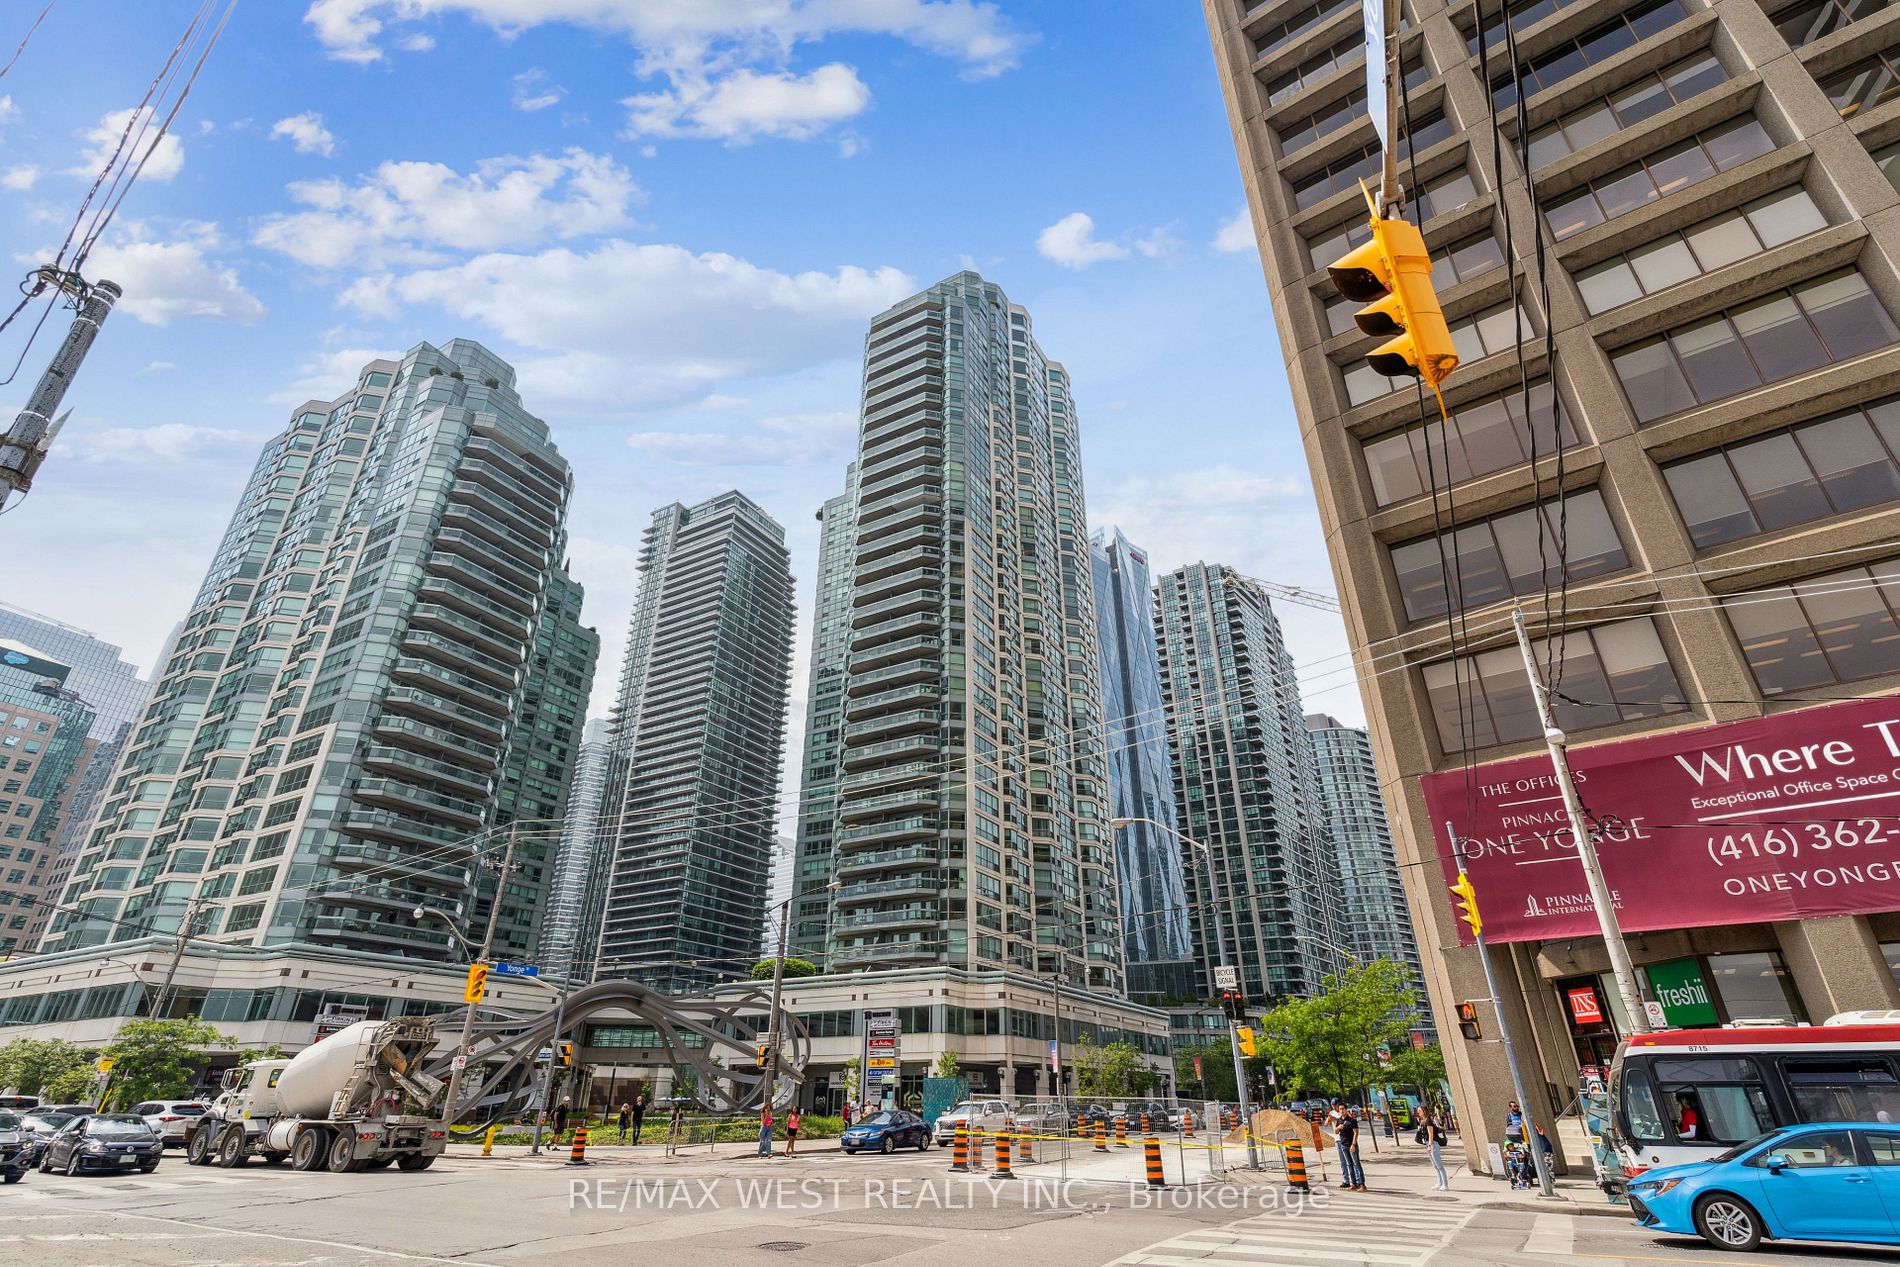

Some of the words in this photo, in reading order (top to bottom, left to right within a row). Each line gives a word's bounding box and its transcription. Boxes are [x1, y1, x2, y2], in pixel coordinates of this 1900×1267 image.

[1674, 740, 1856, 786] Where
[1478, 781, 1512, 798] THE
[1691, 785, 1780, 810] Exceptional
[1783, 779, 1833, 797] Office
[1836, 772, 1889, 792] Space
[1501, 808, 1587, 829] PINNAC
[1462, 832, 1526, 859] ONE
[1533, 816, 1652, 851] YOGE
[1707, 827, 1799, 868] (416)
[1545, 890, 1622, 908] PINNAE
[1548, 902, 1625, 915] INTERNATAL
[507, 964, 526, 975] Yonge
[1216, 968, 1234, 976] BICYCLE
[1656, 977, 1709, 1008] freshii
[1572, 995, 1597, 1012] INS
